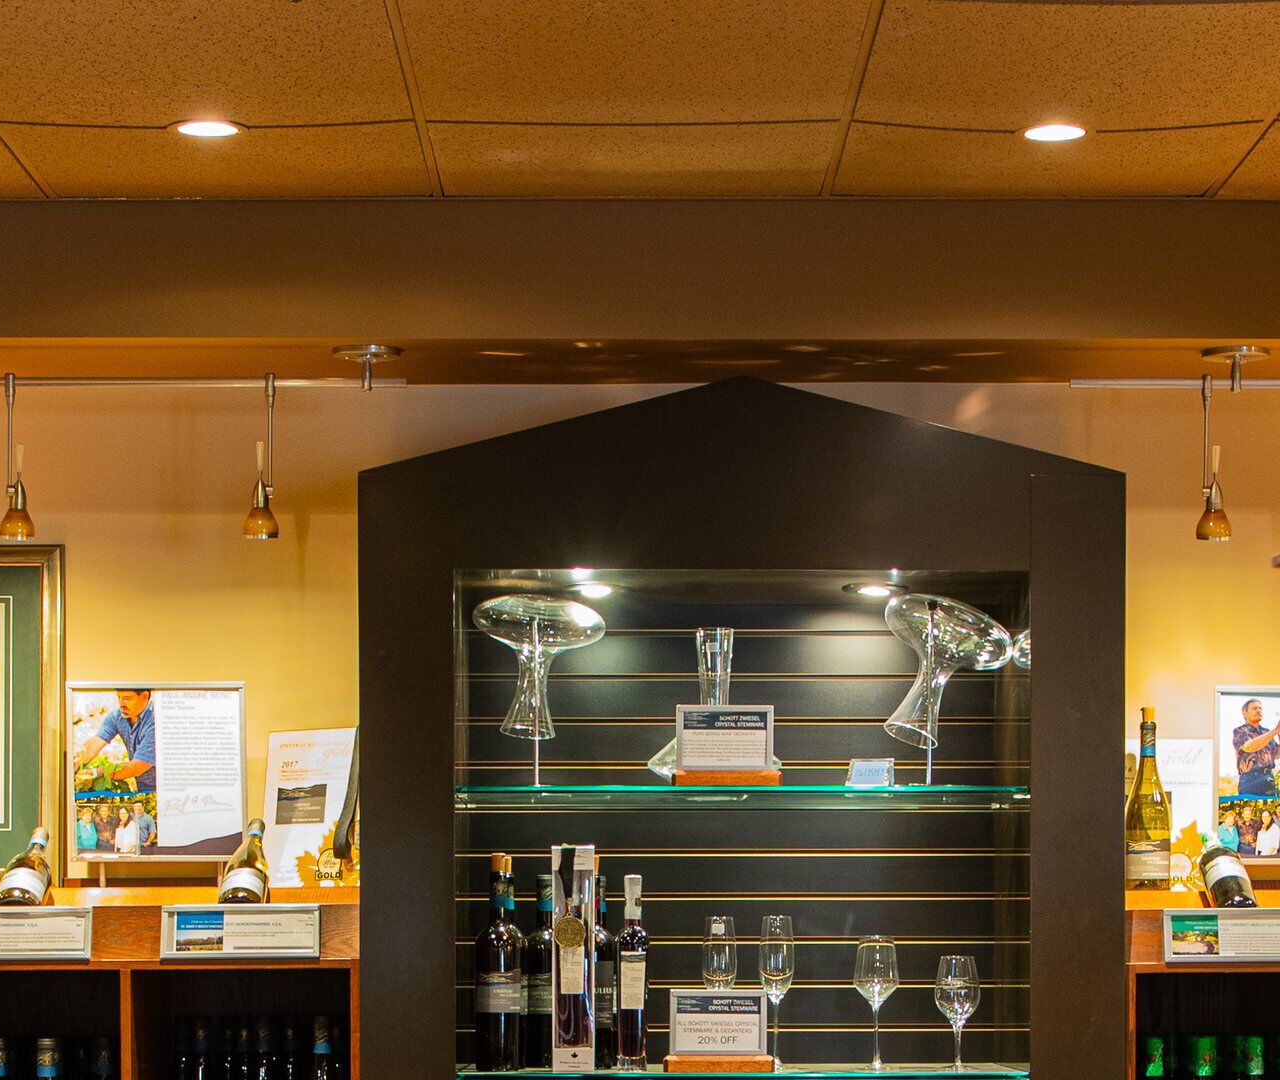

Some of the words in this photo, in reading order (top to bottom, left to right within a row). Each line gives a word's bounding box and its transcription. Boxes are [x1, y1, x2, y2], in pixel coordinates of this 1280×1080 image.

[317, 871, 341, 880] GOLD
[1170, 874, 1194, 883] OLD
[698, 1036, 718, 1045] 20%
[720, 1036, 738, 1045] OFF
